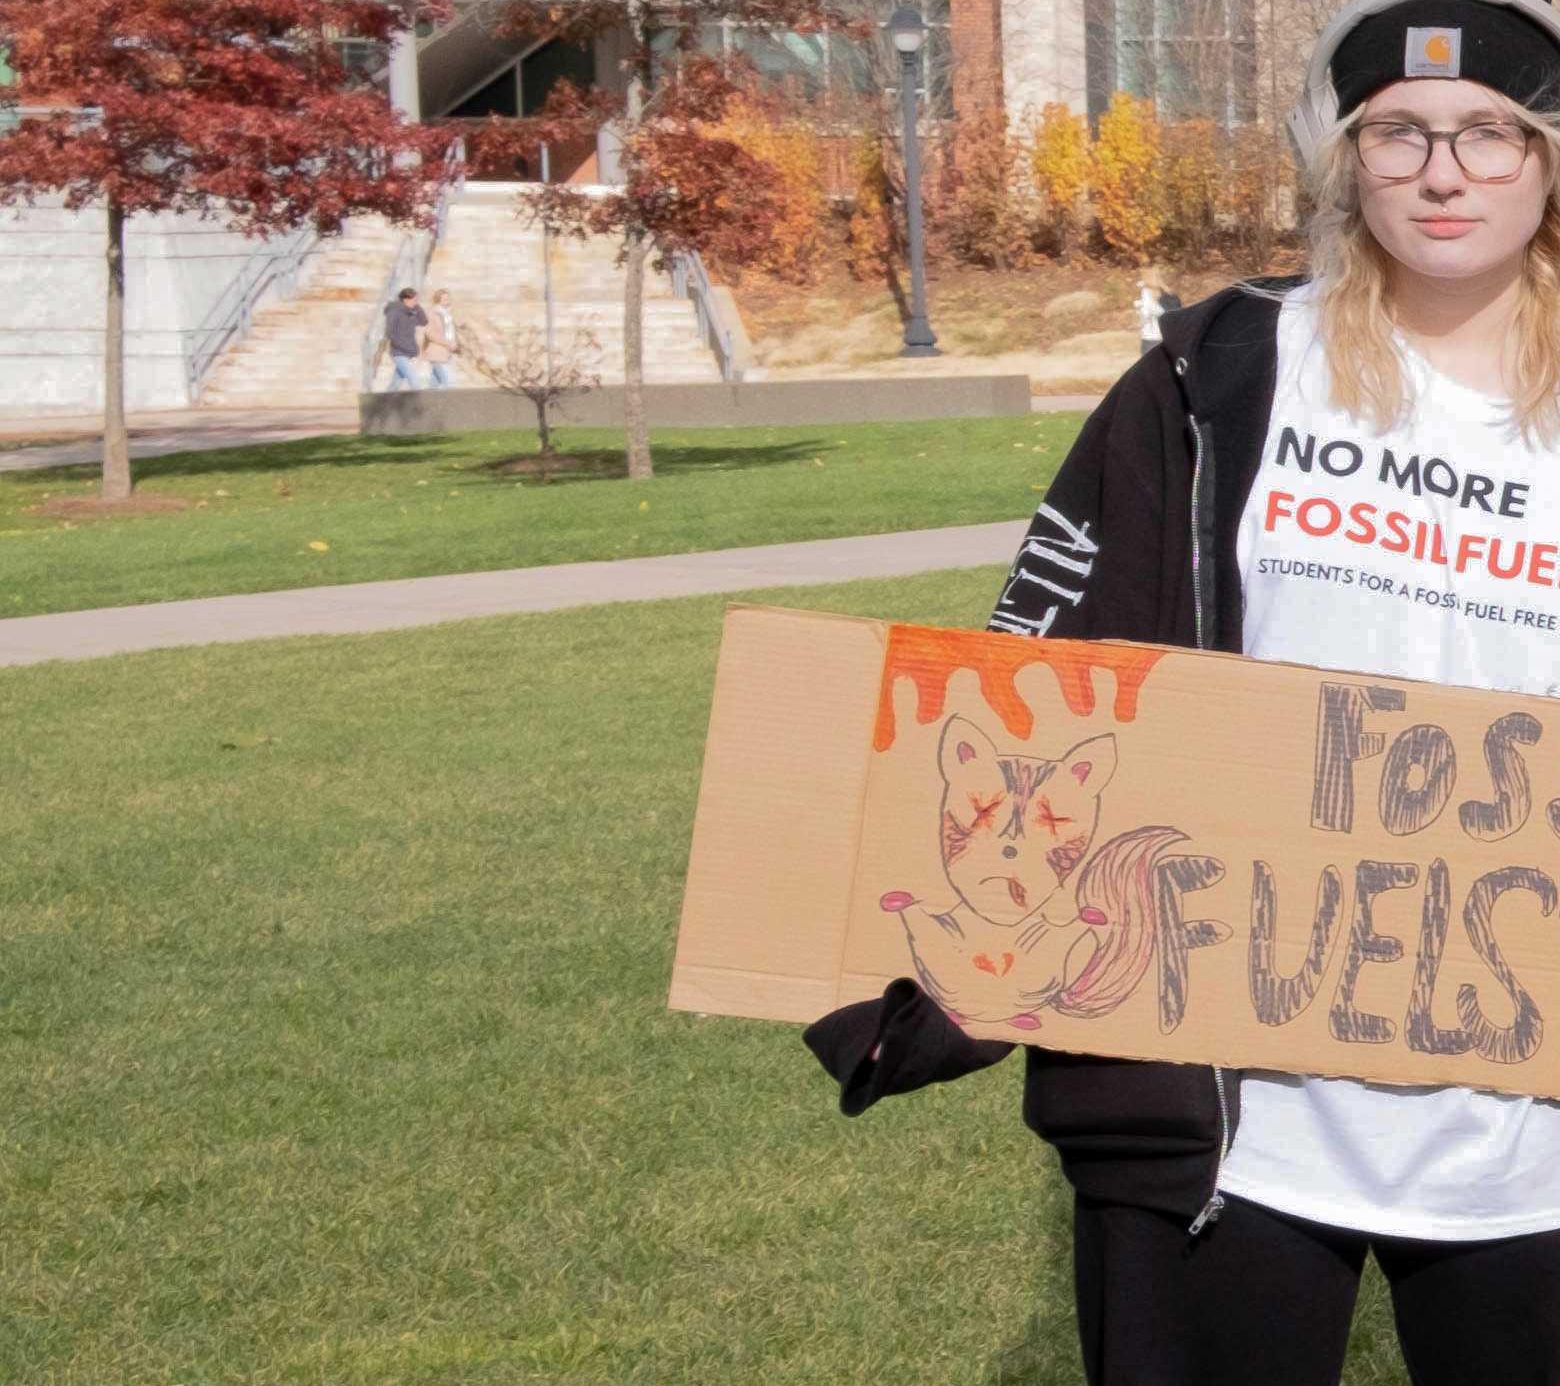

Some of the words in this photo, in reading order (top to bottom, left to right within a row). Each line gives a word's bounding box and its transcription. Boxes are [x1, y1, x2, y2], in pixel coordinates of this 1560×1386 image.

[1275, 426, 1363, 477] NO
[1378, 447, 1531, 519] MORE
[1264, 490, 1449, 566] FOSSIL
[1257, 558, 1355, 585] STUDENTS
[1359, 571, 1395, 596] FOR
[1399, 584, 1411, 600] A
[1464, 602, 1507, 622] FUEL
[1513, 609, 1557, 631] FREE
[1158, 855, 1560, 1068] FUELS
